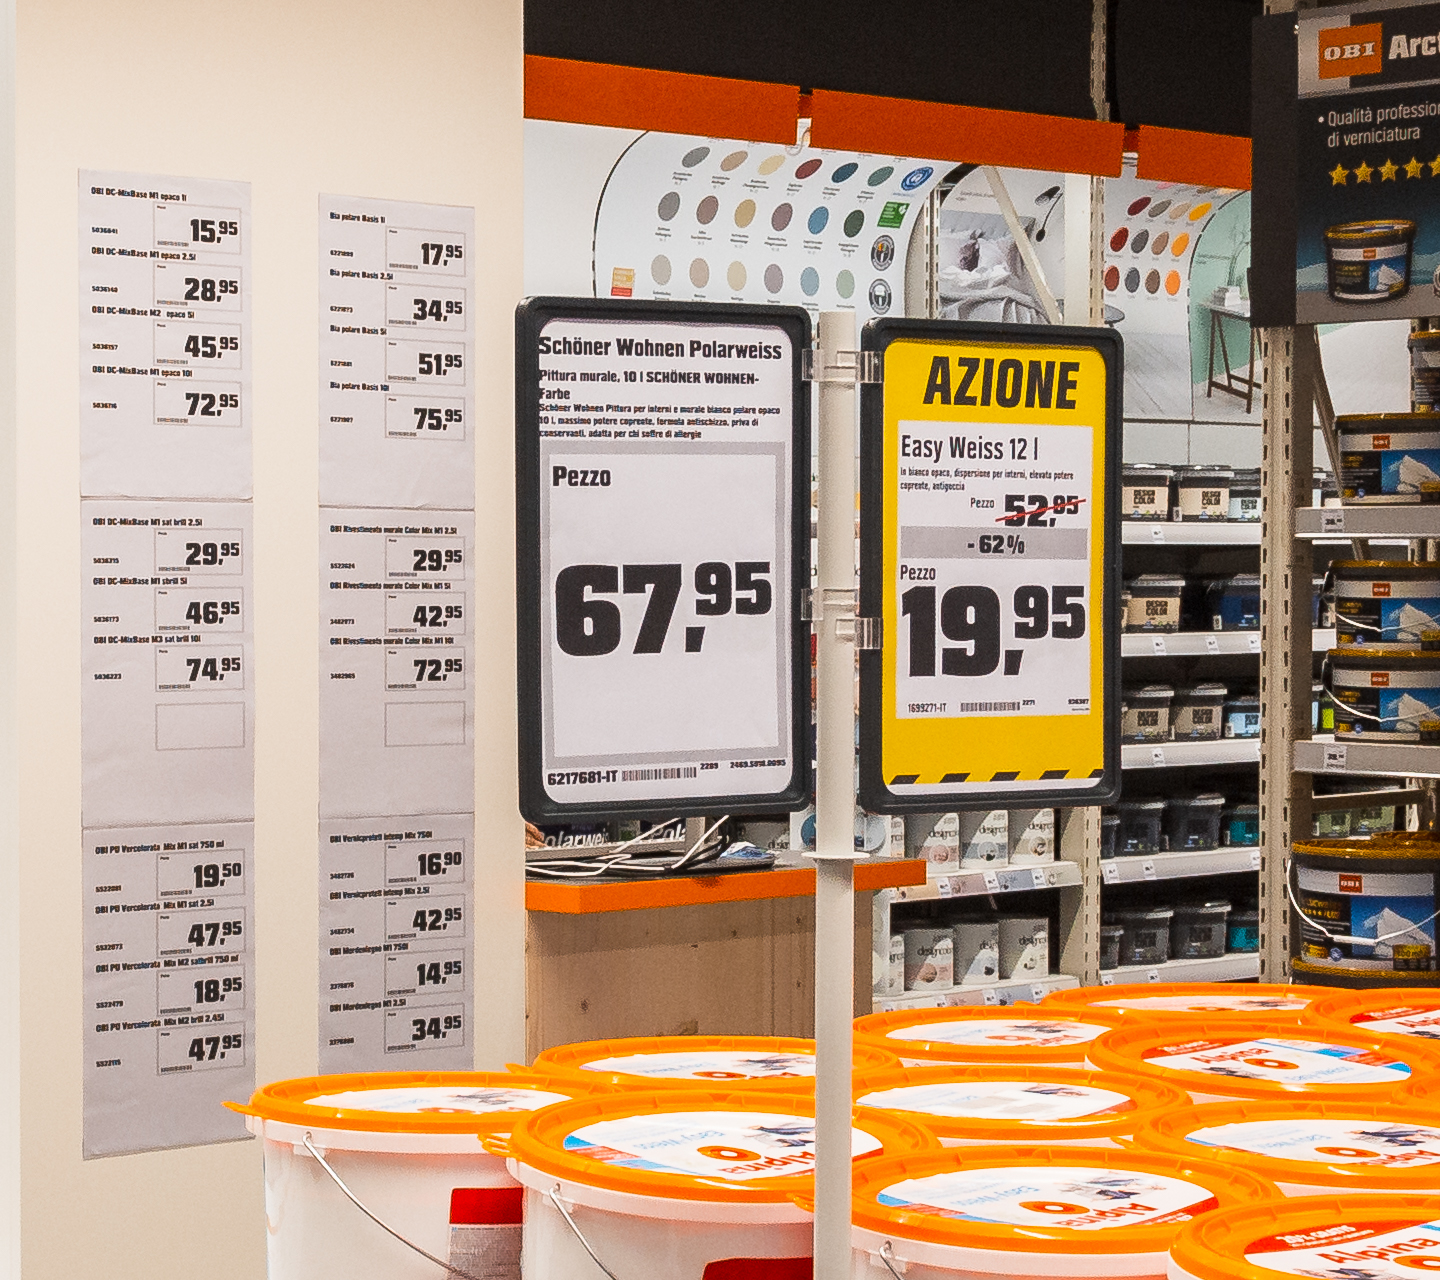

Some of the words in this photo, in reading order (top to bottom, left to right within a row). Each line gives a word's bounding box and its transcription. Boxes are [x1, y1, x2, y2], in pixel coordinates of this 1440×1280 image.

[1323, 42, 1376, 62] OBI
[1328, 106, 1372, 128] Qualità
[1328, 131, 1341, 148] di
[1343, 125, 1421, 147] verniciatura
[189, 217, 239, 245] 15,95
[420, 242, 463, 267] 17,95
[183, 277, 240, 304] 28,95
[183, 335, 240, 360] 45,95
[539, 336, 611, 356] Schöner
[616, 338, 685, 358] Wohnen
[689, 340, 782, 360] Polarweiss
[418, 353, 463, 377] 51,95
[539, 369, 577, 382] Pittura
[580, 370, 620, 383] murale,
[623, 371, 637, 382] 10
[646, 369, 701, 384] SCHÖNER
[704, 372, 759, 385] WOHNEN-
[539, 387, 570, 400] Farbe
[922, 355, 1081, 410] AZIONE
[901, 435, 943, 463] Easy
[949, 435, 1003, 460] Weiss
[1009, 438, 1027, 460] 12
[552, 466, 611, 487] Pezzo
[970, 497, 995, 509] Pezzo
[184, 541, 240, 567] 29,95
[900, 564, 936, 581] Pezzo
[554, 560, 773, 657] 67,95
[901, 584, 1086, 678] 19,95
[907, 700, 947, 714] 1699271-IT
[547, 768, 619, 787] 6217681-IT
